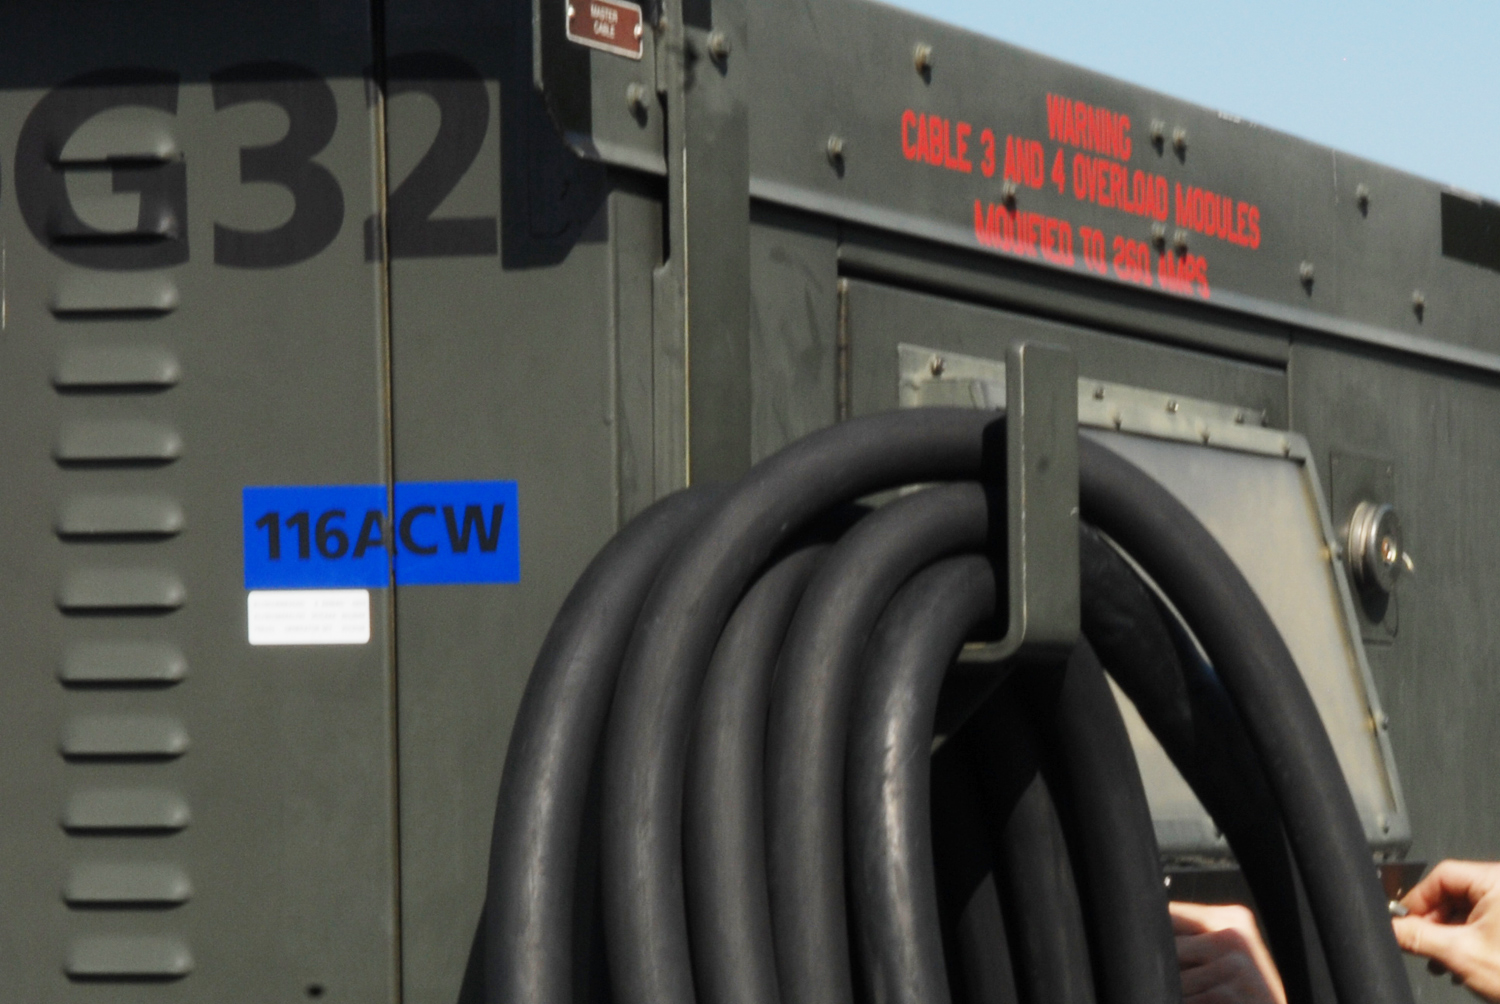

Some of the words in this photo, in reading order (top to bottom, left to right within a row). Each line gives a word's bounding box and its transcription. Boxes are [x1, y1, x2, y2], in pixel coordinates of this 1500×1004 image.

[1046, 92, 1132, 162] WARNING
[901, 109, 973, 174] CABLE
[980, 128, 996, 178] 3
[1003, 135, 1045, 190] AND
[1051, 148, 1066, 195] 4
[1072, 152, 1169, 222] OVERLOAD
[1175, 182, 1261, 250] MODULES
[974, 199, 1076, 267] MODIFIED
[1079, 226, 1107, 276] TO
[1157, 247, 1211, 300] AMPS
[255, 503, 505, 560] 116ACW
